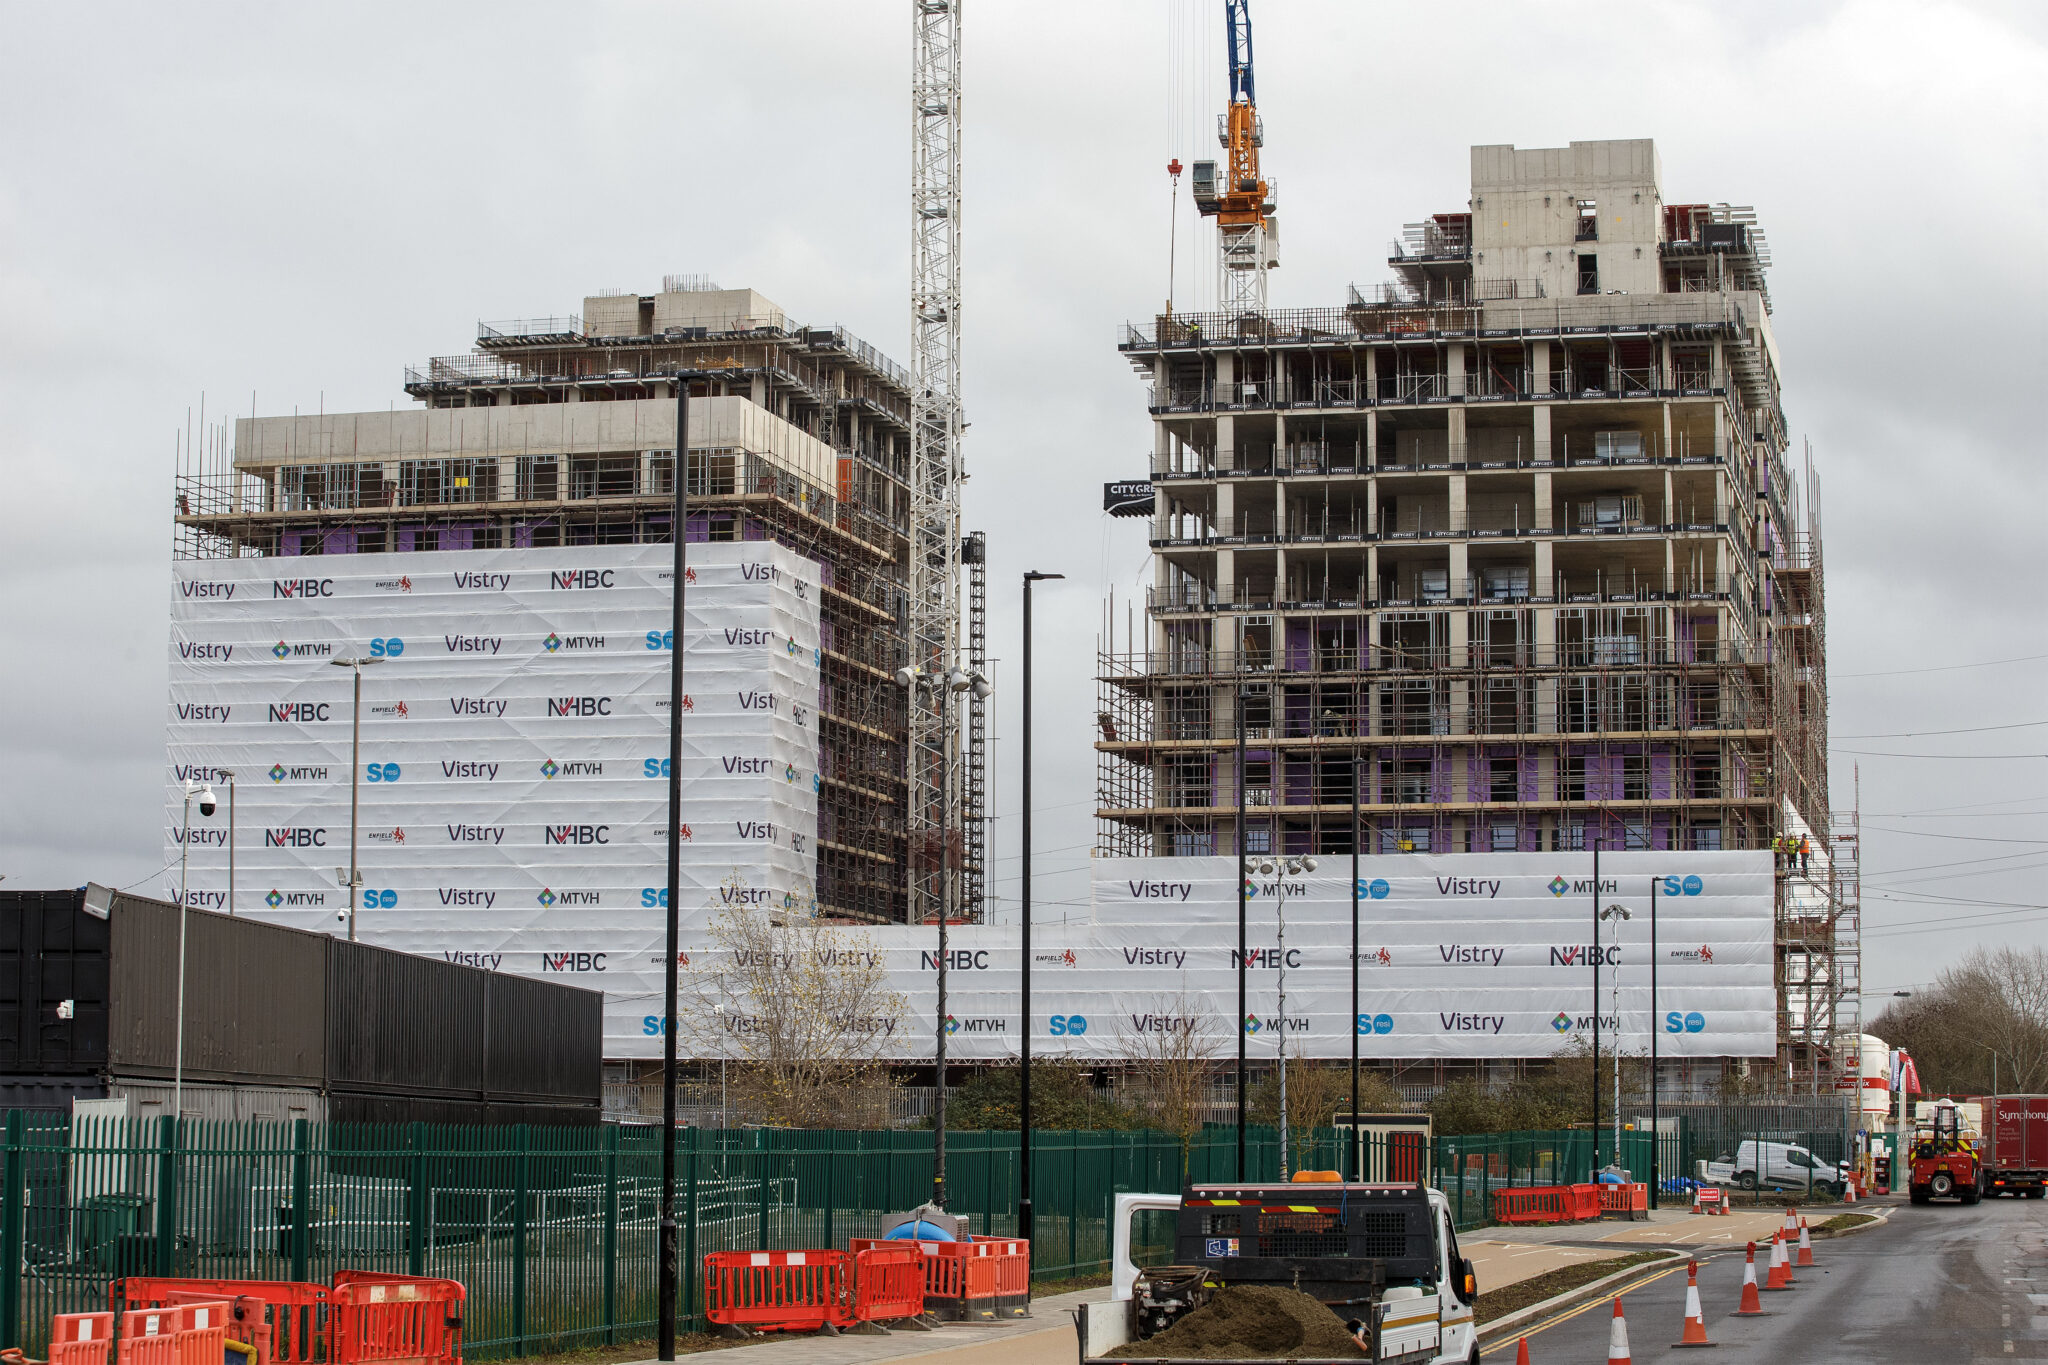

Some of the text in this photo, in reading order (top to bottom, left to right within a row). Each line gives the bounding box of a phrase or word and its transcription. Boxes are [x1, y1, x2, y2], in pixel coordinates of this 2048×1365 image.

[1110, 484, 1155, 494] CITYGRE
[273, 579, 333, 599] NHBC
[454, 571, 510, 591] Vistry
[552, 569, 614, 589] NHBC
[181, 580, 235, 600] Vistry
[179, 641, 232, 661] Vistry
[294, 644, 331, 656] MTVH
[445, 635, 502, 655] Vistry
[566, 636, 605, 649] MTVH
[177, 703, 231, 723] Vistry
[269, 703, 330, 723] NHBC
[450, 697, 507, 717] Vistry
[548, 696, 612, 717] NHBC
[290, 768, 327, 780] MTVH
[441, 761, 498, 781] Vistry
[563, 763, 602, 775] MTVH
[173, 827, 227, 847] Vistry
[266, 828, 326, 847] NHBC
[447, 824, 504, 844] Vistry
[546, 824, 609, 844] NHBC
[1129, 880, 1192, 902] Vistry
[1436, 876, 1501, 899] Vistry
[172, 888, 225, 908] Vistry
[287, 893, 324, 905] MTVH
[438, 888, 495, 909] Vistry
[560, 892, 599, 905] MTVH
[543, 952, 607, 971] NHBC
[1123, 947, 1186, 969] Vistry
[1439, 944, 1504, 966] Vistry
[964, 1019, 1005, 1032] MTVH
[1070, 1021, 1084, 1029] resi
[1132, 1014, 1195, 1034] Vistry
[1377, 1020, 1390, 1028] resi
[1440, 1012, 1504, 1034] Vistry
[1999, 1109, 2048, 1121] Symphony
